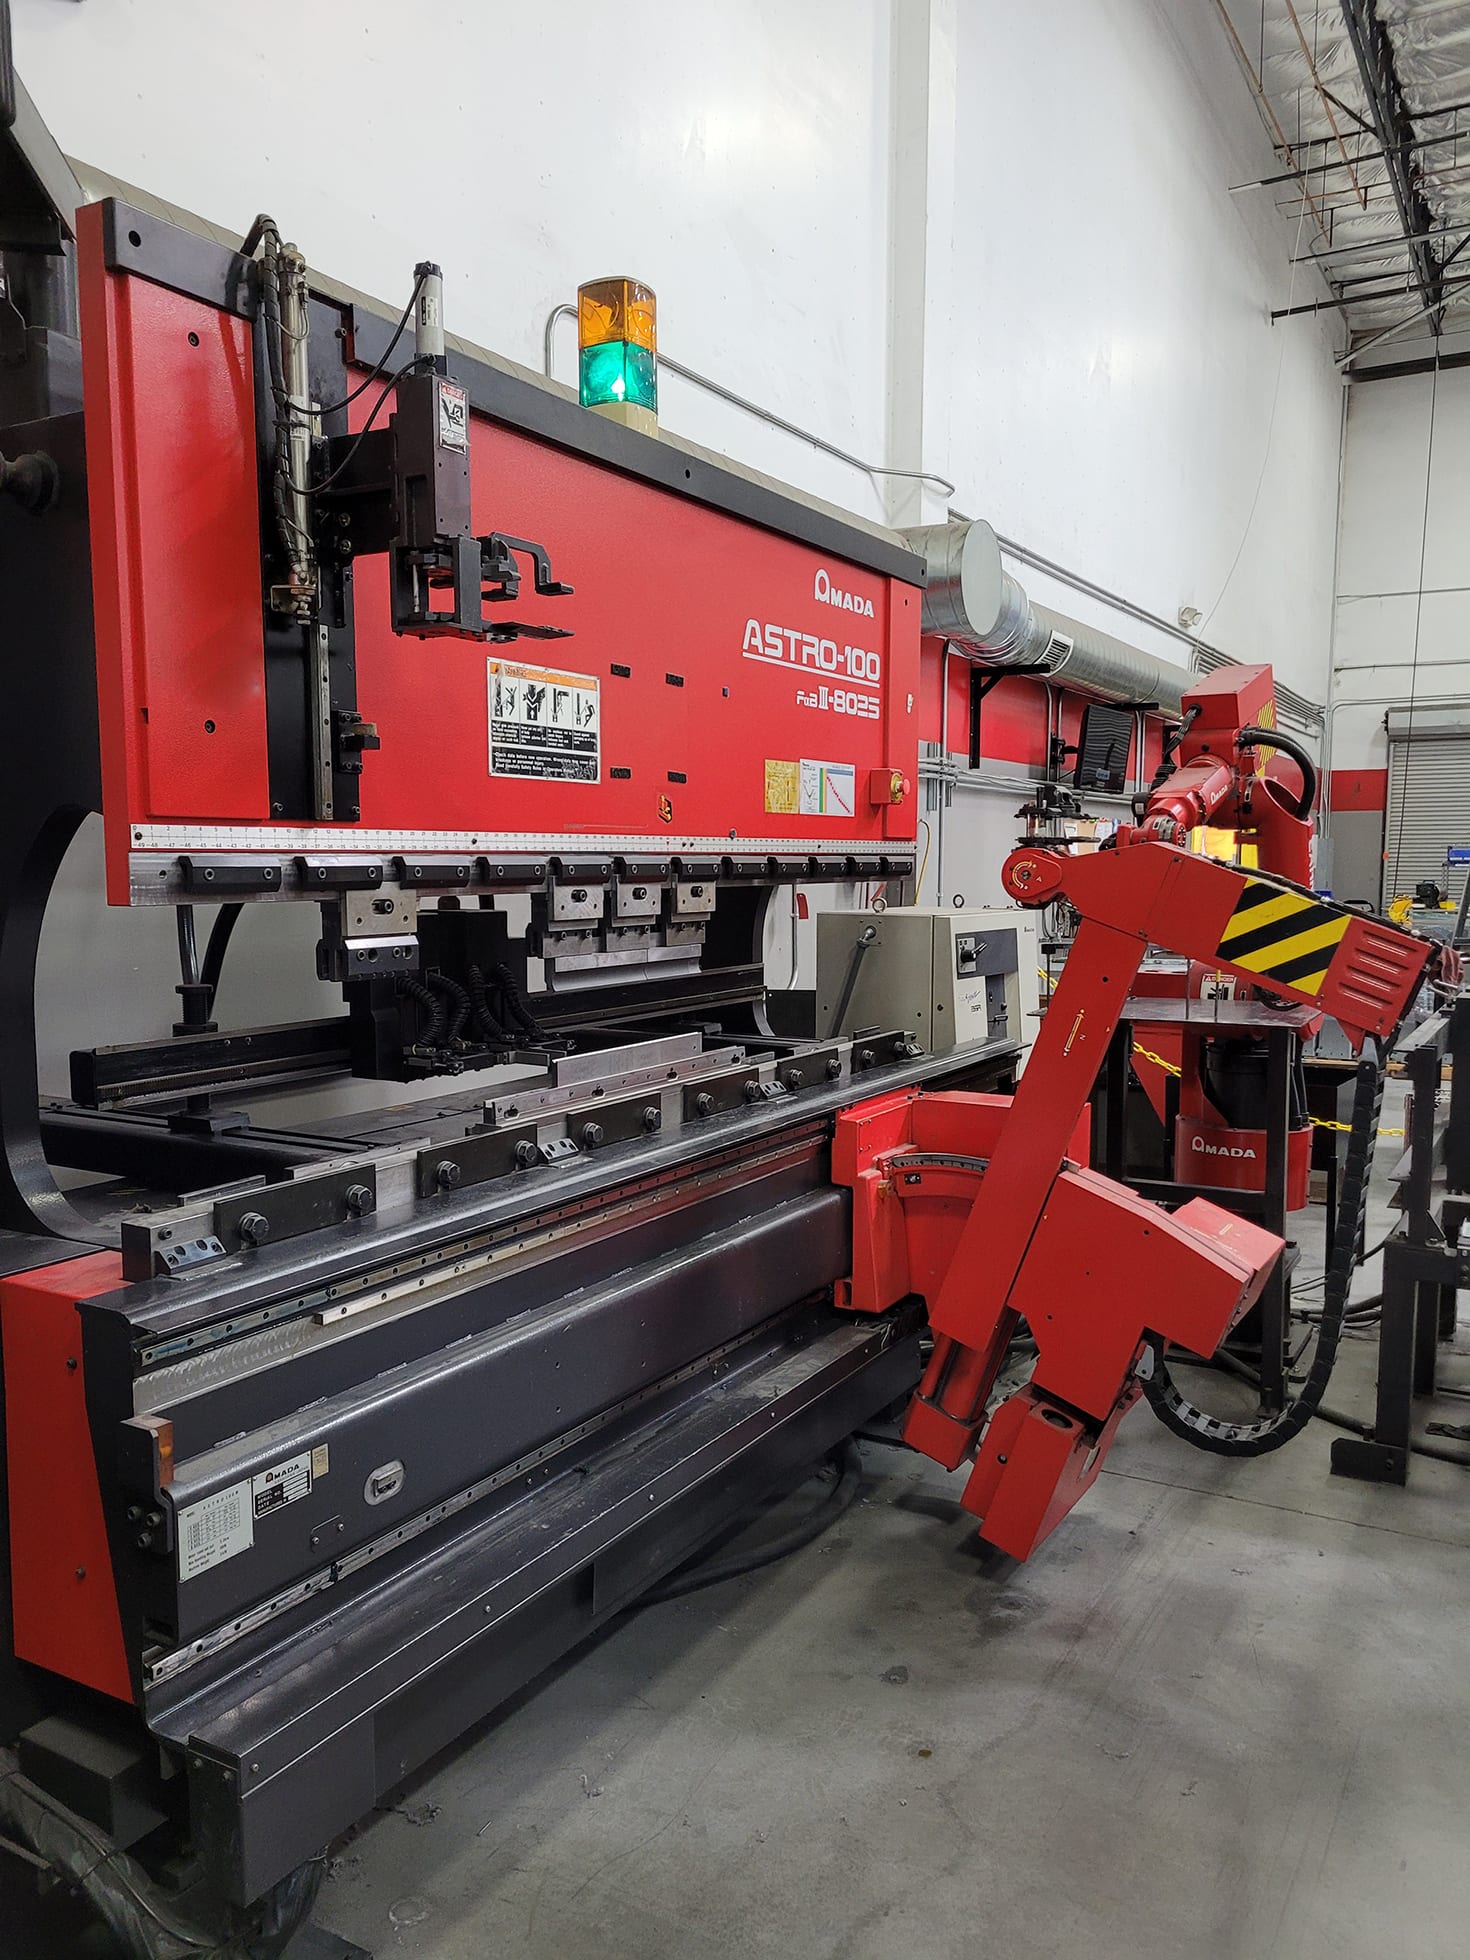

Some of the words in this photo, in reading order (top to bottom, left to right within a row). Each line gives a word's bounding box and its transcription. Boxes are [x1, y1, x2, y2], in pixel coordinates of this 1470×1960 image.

[814, 568, 875, 618] AMADA
[742, 618, 881, 682] ASTRO-100
[1191, 1135, 1257, 1159] AMADA
[265, 1463, 300, 1484] AMADA
